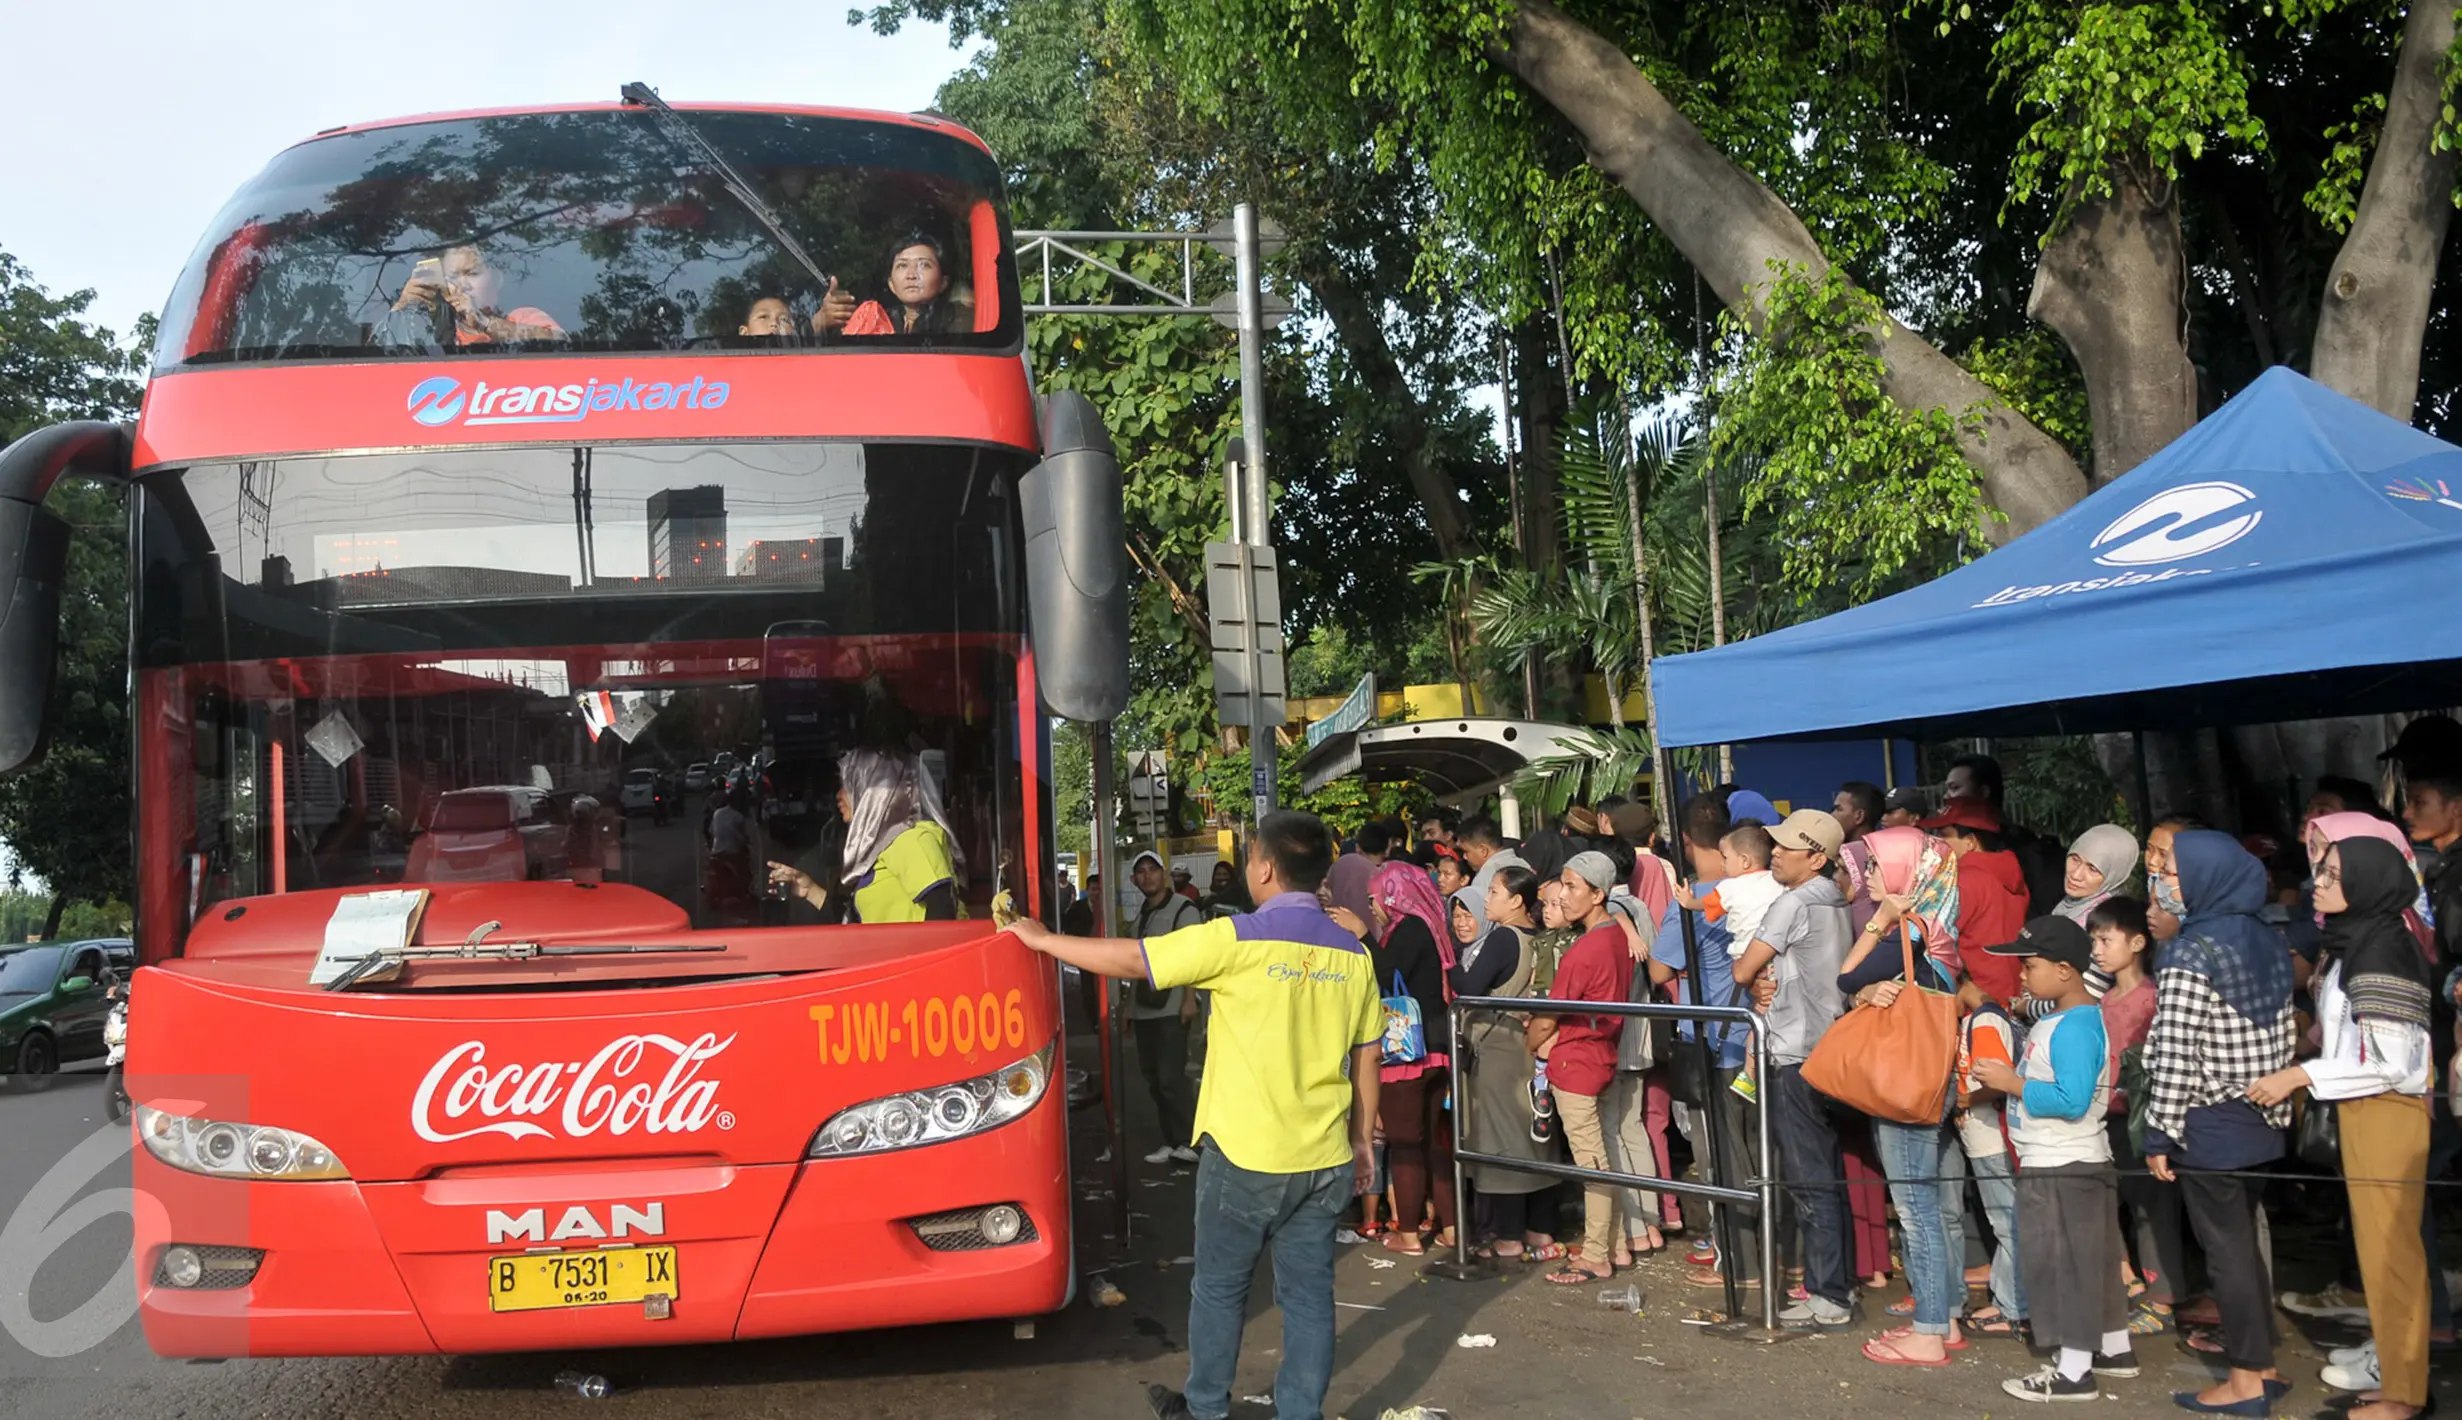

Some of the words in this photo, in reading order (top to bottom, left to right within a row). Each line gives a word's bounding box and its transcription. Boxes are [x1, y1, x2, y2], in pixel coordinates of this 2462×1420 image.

[468, 376, 731, 425] transjakarta
[809, 988, 1025, 1065] TJW-10006
[411, 1031, 738, 1143] Coca-Cola
[486, 1202, 666, 1244] MAN
[500, 1262, 516, 1292] B
[549, 1256, 608, 1289] 7531
[645, 1252, 670, 1283] IX
